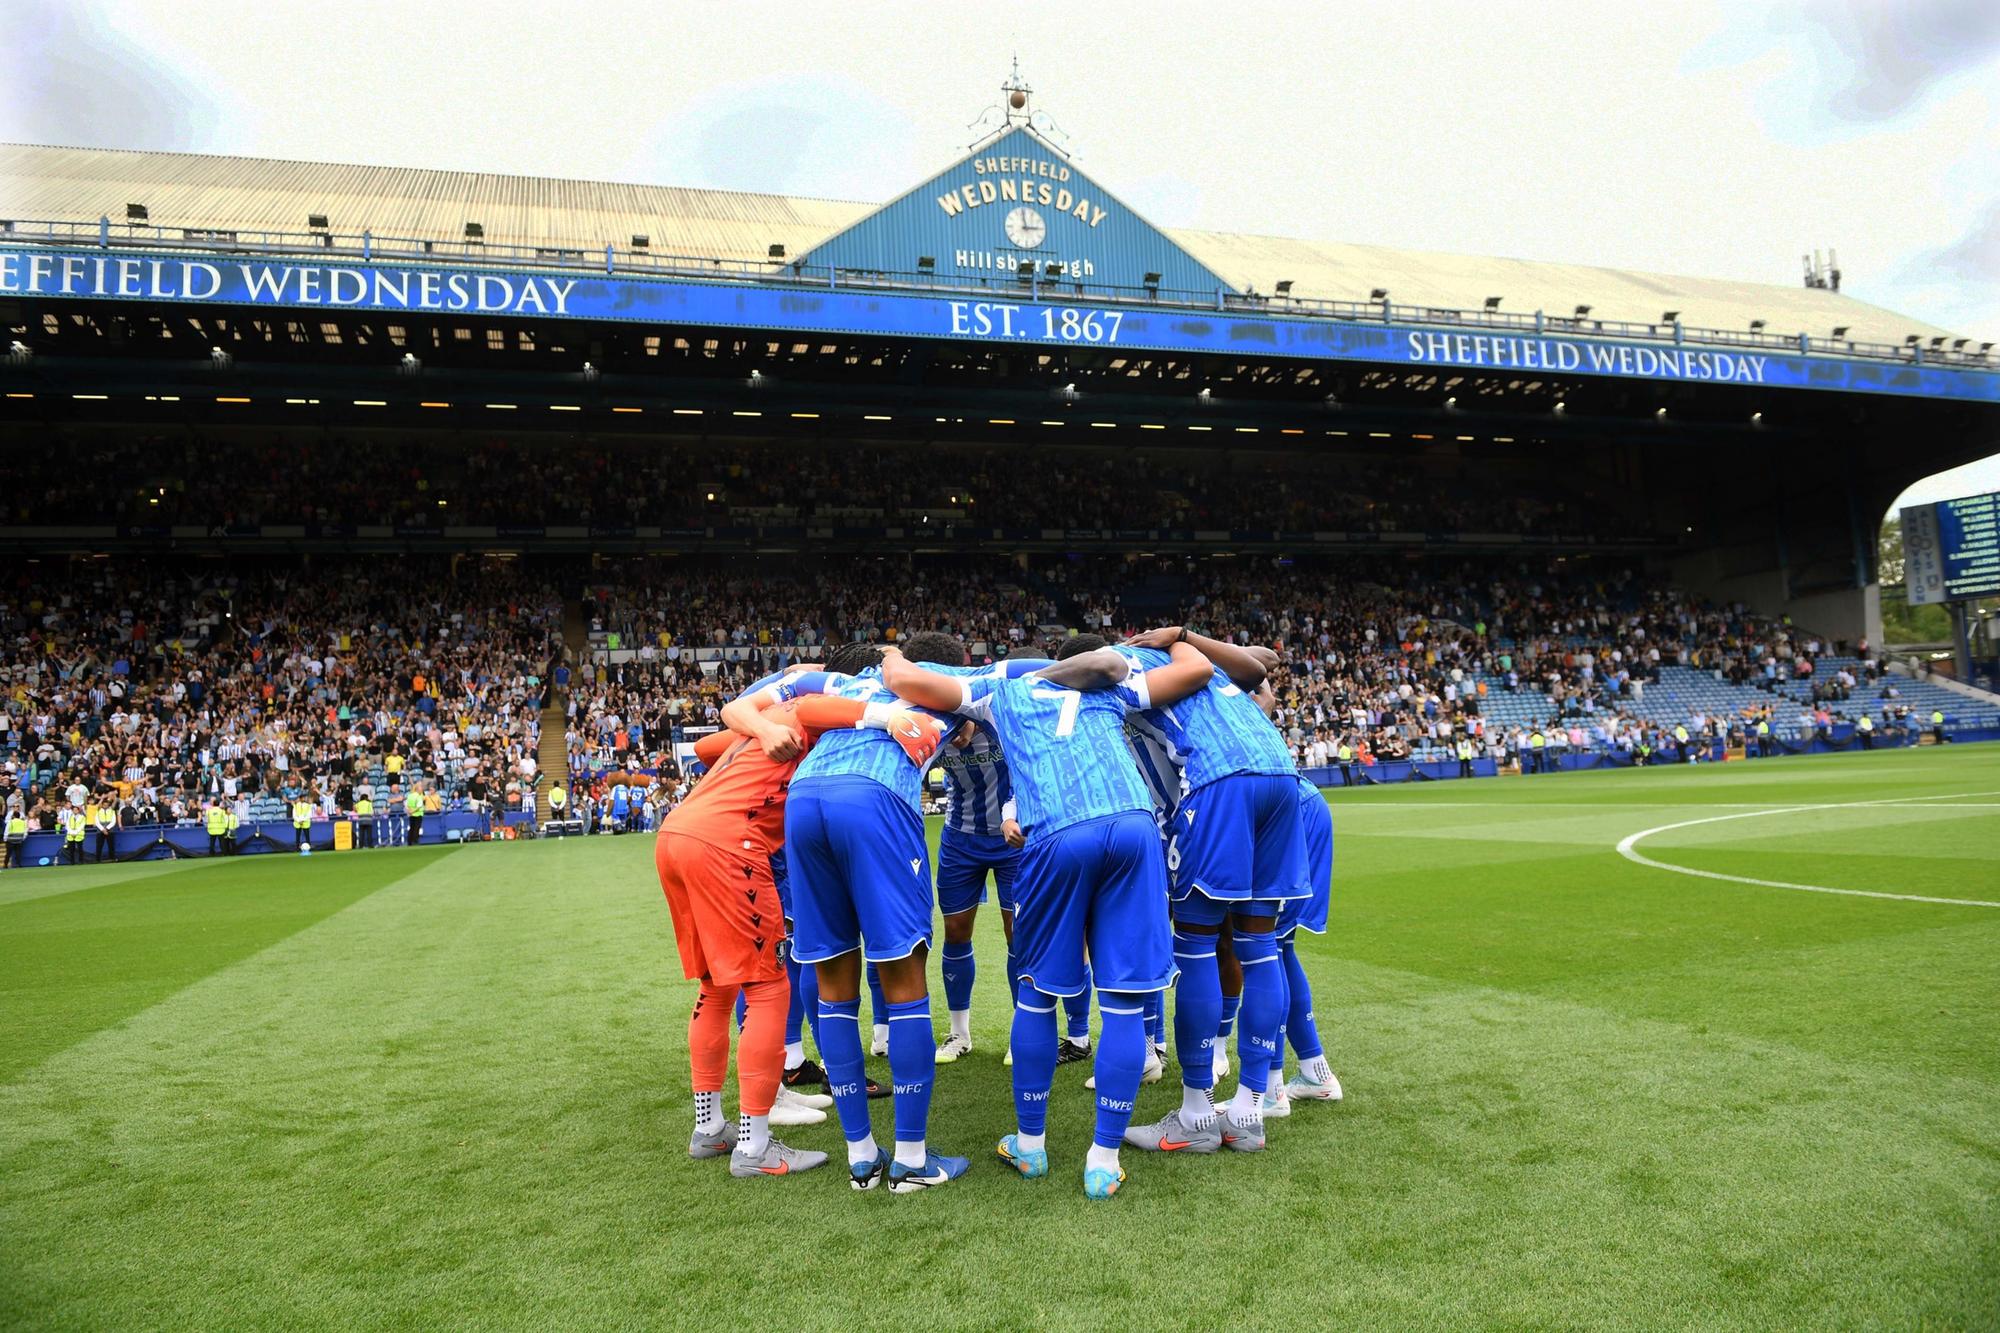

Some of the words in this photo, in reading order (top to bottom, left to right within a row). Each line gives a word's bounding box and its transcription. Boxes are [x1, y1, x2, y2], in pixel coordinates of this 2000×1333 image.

[974, 157, 1070, 182] SHEFFIELD
[937, 179, 1107, 228] WEDNESDAY
[0, 253, 222, 299] EFFIELD
[237, 264, 579, 314] WEDNESDAY
[949, 302, 1026, 337] EST.
[1040, 308, 1124, 343] 1867
[1408, 332, 1580, 370] SHEFFIELD
[1586, 344, 1768, 383] WEDNESDAY
[1031, 688, 1081, 737] 7
[632, 792, 643, 801] 67
[1167, 834, 1181, 871] 6
[1100, 1096, 1133, 1111] SWFC
